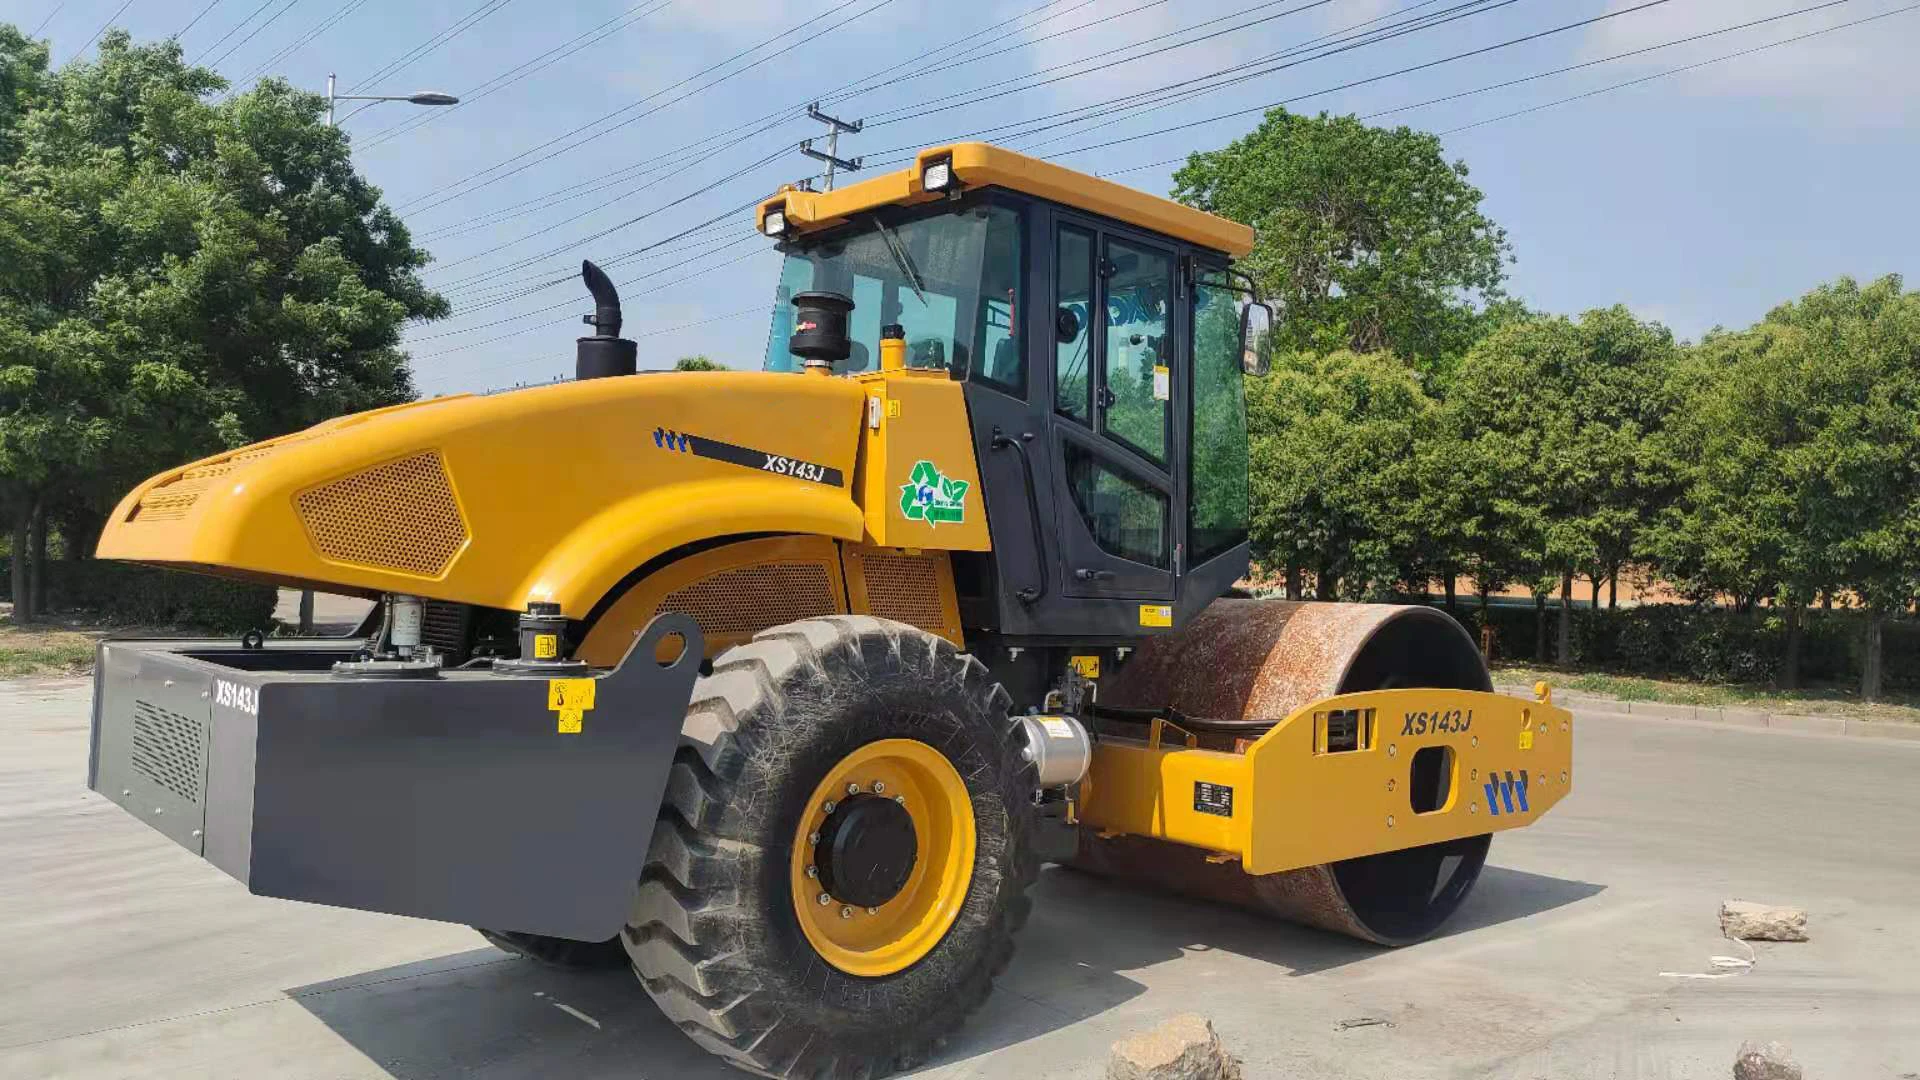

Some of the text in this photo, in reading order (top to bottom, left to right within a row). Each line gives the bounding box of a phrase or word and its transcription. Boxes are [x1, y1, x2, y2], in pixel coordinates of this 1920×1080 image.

[762, 454, 825, 482] XS143J
[216, 679, 259, 716] XS143J
[1401, 709, 1473, 736] XS143J
